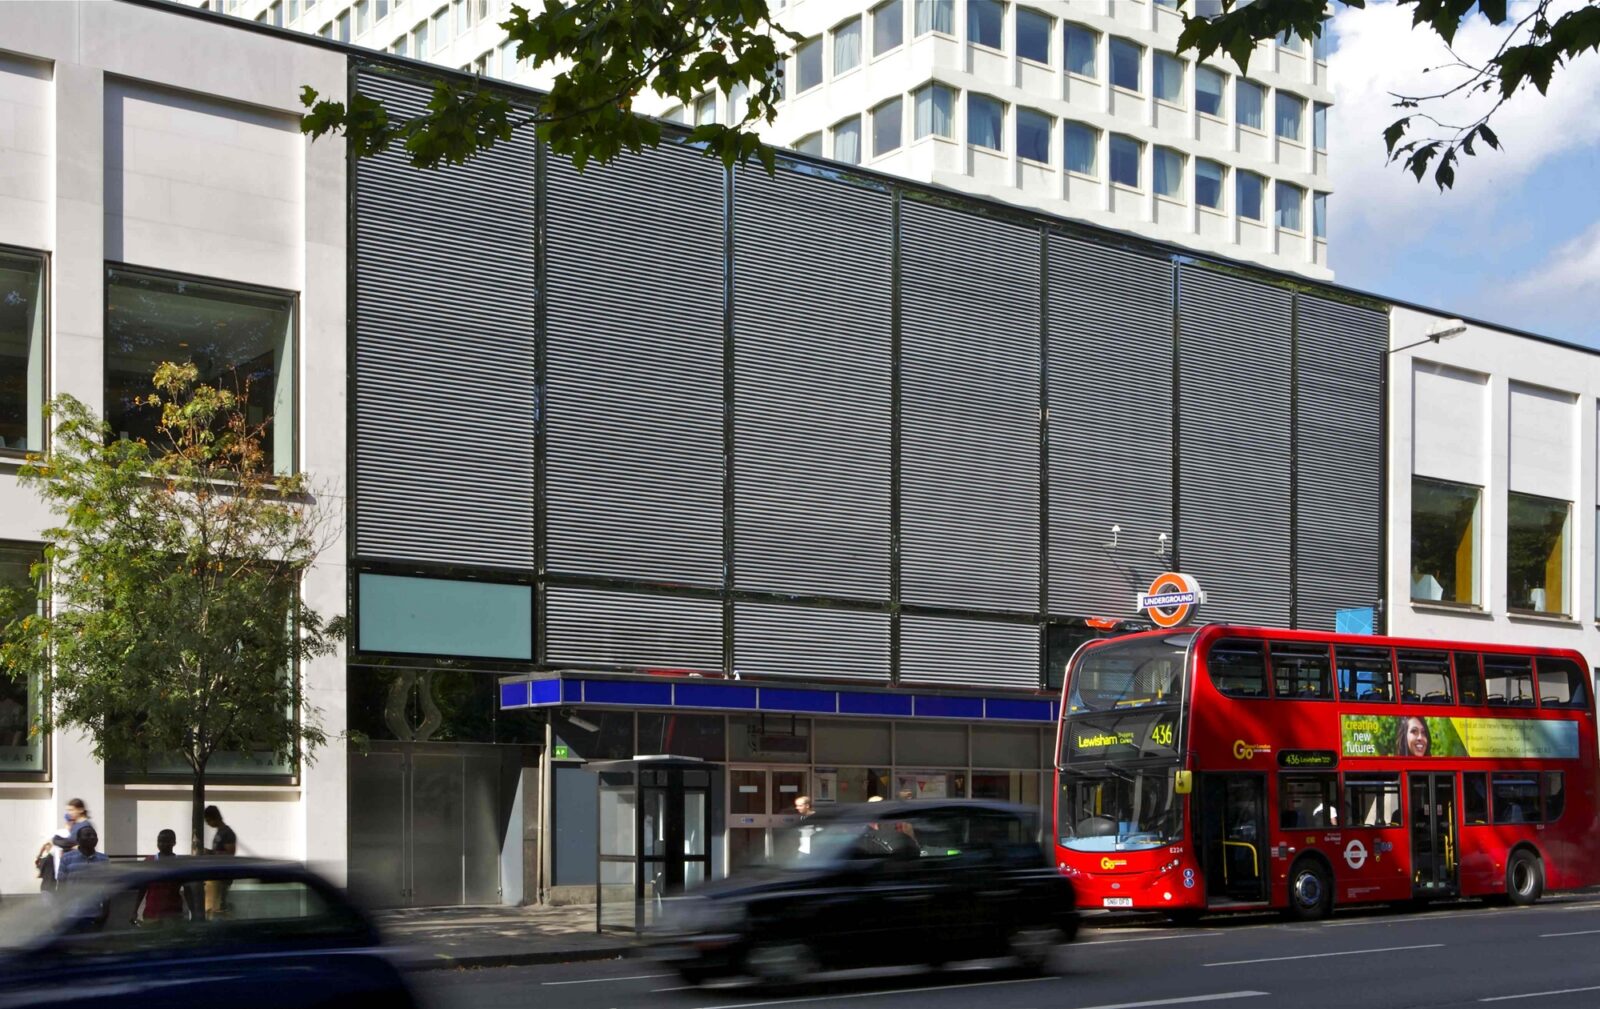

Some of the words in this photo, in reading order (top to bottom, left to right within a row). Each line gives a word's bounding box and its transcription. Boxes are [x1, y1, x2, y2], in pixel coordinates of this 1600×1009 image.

[1144, 594, 1193, 606] UNDERGROUND
[1346, 720, 1378, 734] creating
[1078, 733, 1118, 748] Lewisham
[1151, 724, 1172, 745] 436
[1353, 732, 1371, 741] new
[1346, 741, 1375, 753] futures
[1285, 754, 1300, 765] 436
